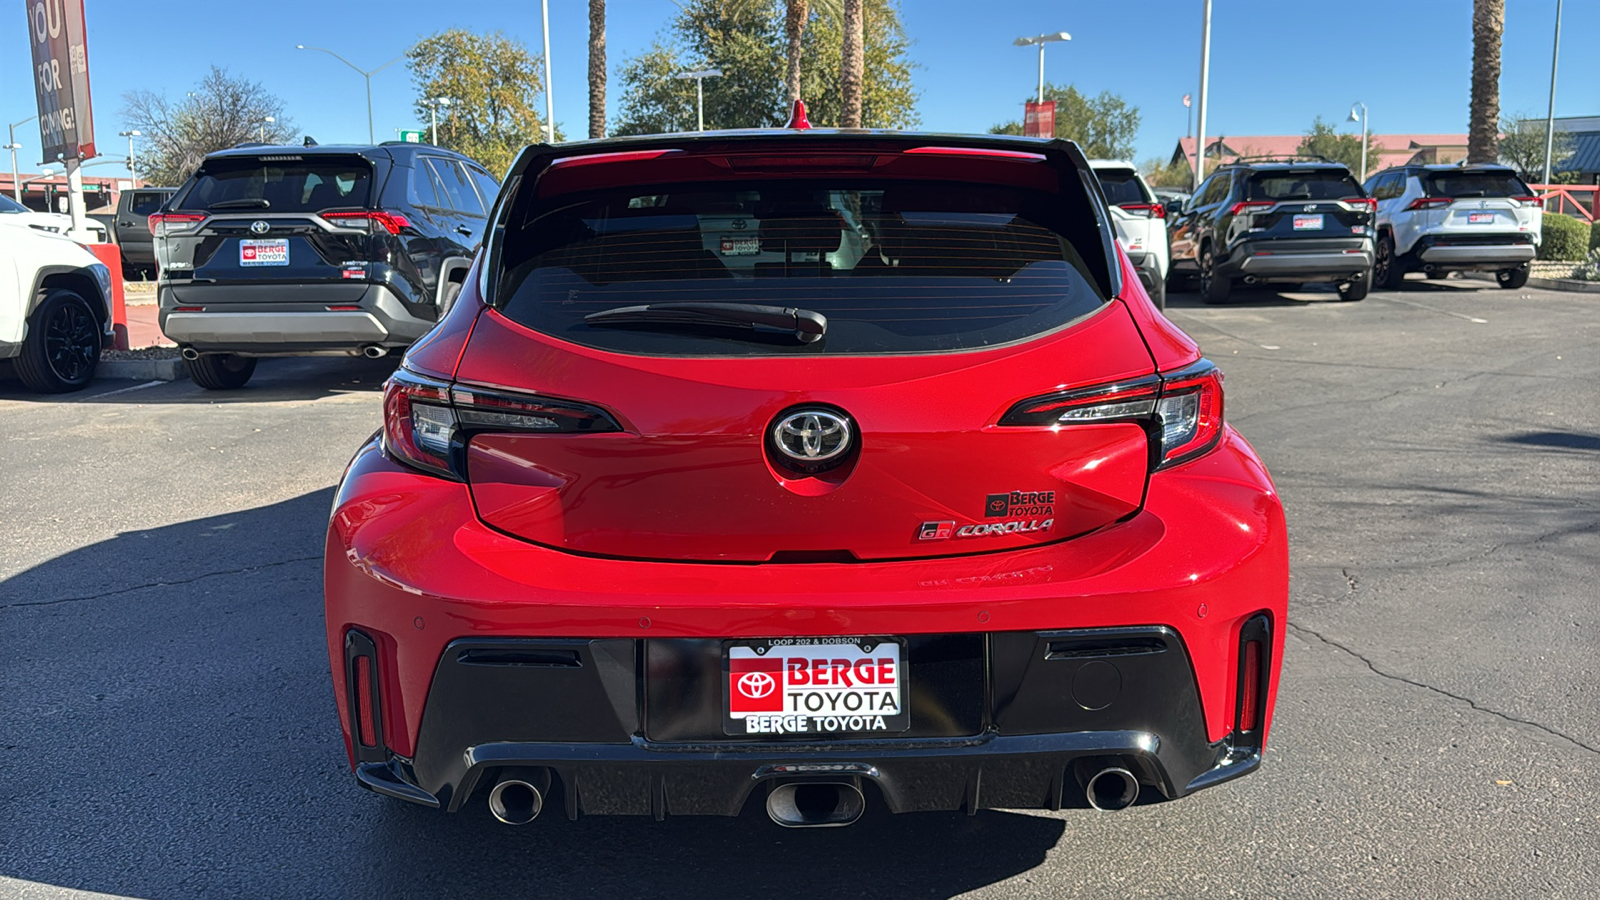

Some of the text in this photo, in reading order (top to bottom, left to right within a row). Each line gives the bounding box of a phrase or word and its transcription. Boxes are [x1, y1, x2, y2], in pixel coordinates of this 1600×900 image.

[29, 0, 61, 47] YOU
[38, 58, 62, 95] FOR
[41, 107, 75, 136] COMING!
[257, 245, 286, 254] BERGE
[1010, 490, 1055, 506] BERGE
[1009, 506, 1053, 516] TOYOTA
[956, 518, 1054, 537] COROLLA
[822, 637, 861, 645] DOBSON
[787, 657, 896, 688] BERGE
[787, 691, 898, 711] TOYOTA
[745, 715, 887, 734] BERGE TOYOTA
